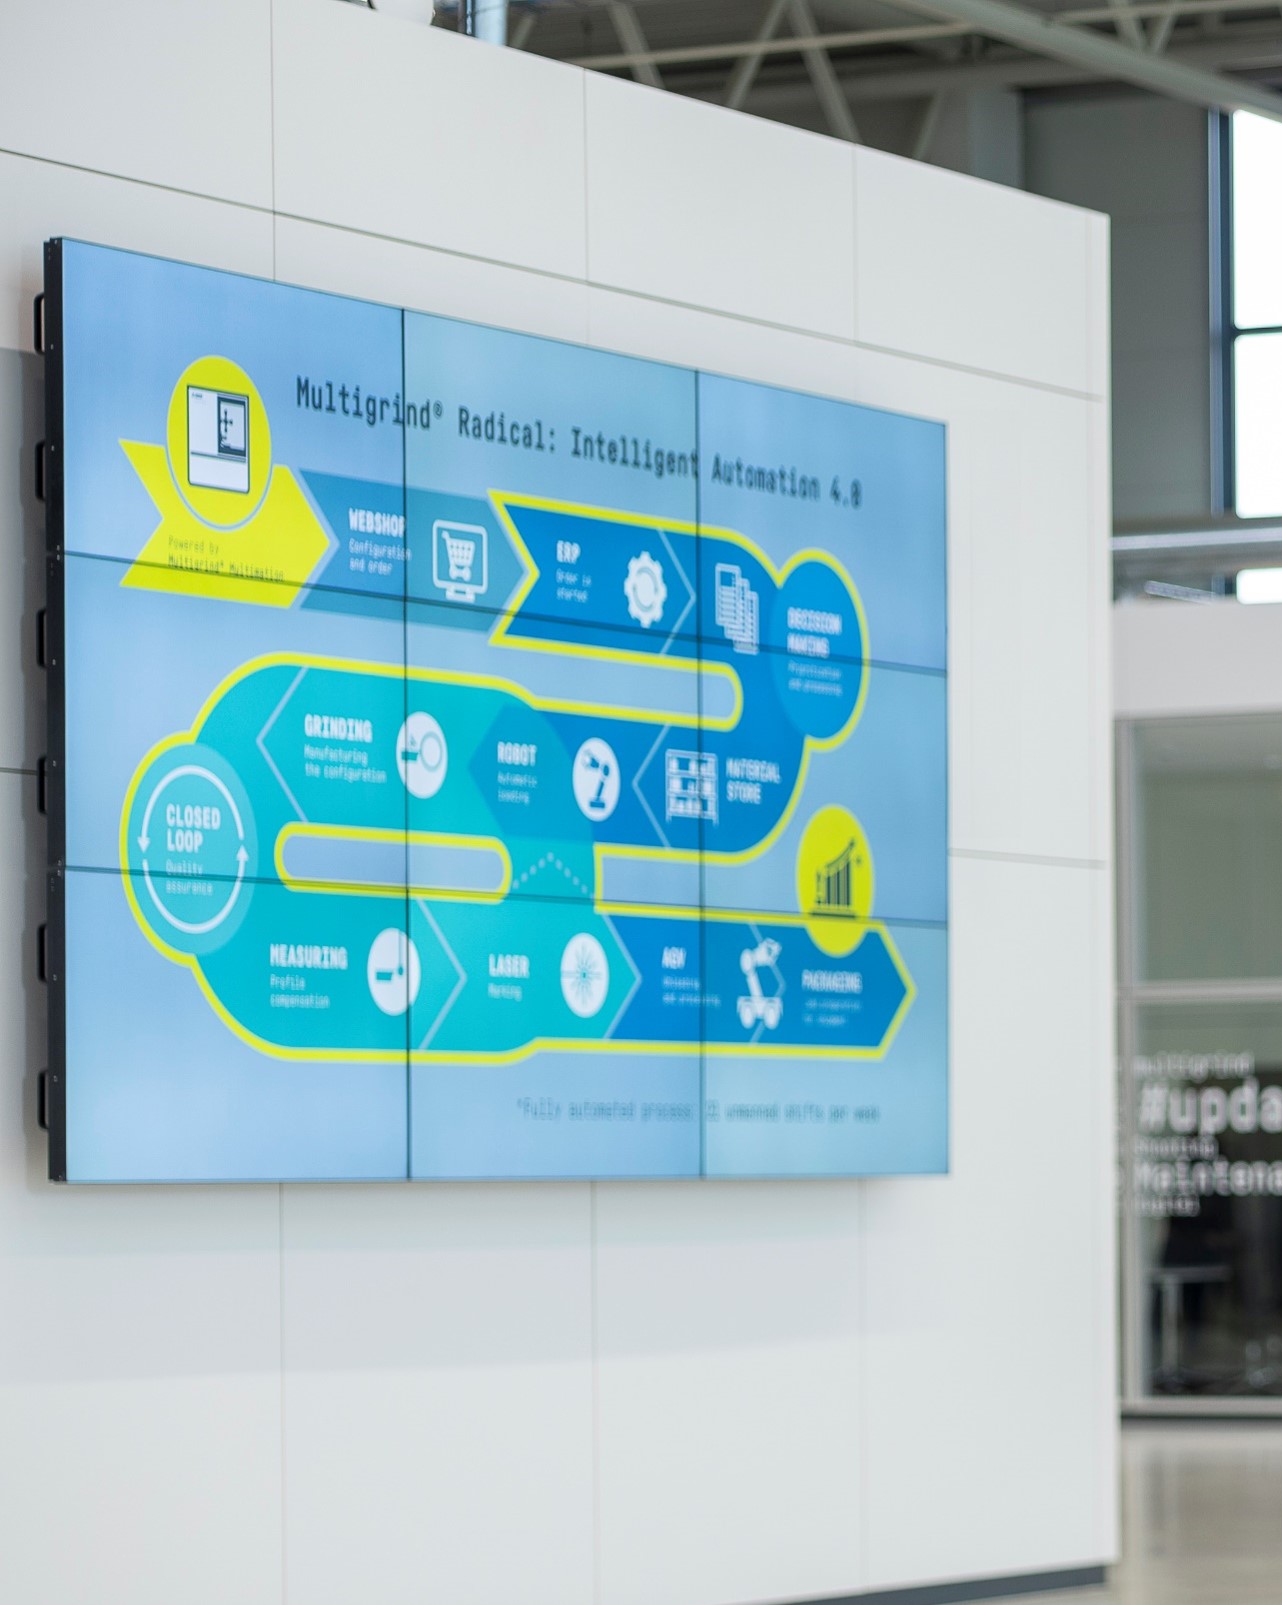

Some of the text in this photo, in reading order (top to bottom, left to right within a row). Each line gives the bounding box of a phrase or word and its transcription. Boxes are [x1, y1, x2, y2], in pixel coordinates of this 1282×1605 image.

[458, 405, 556, 452] Radical:
[571, 427, 699, 480] Intelligent
[711, 452, 820, 502] Automation
[348, 507, 405, 538] WEBSHOP
[556, 539, 581, 565] ERP
[304, 713, 373, 743] GRINDING
[497, 741, 538, 767] ROBOT
[725, 757, 781, 784] MATERIAL
[726, 781, 762, 805] STORE
[166, 803, 221, 830] CLOSED
[166, 828, 203, 854] LOOP
[165, 858, 203, 878] Quality
[269, 943, 349, 970] MEASURING
[488, 953, 530, 979] LASER
